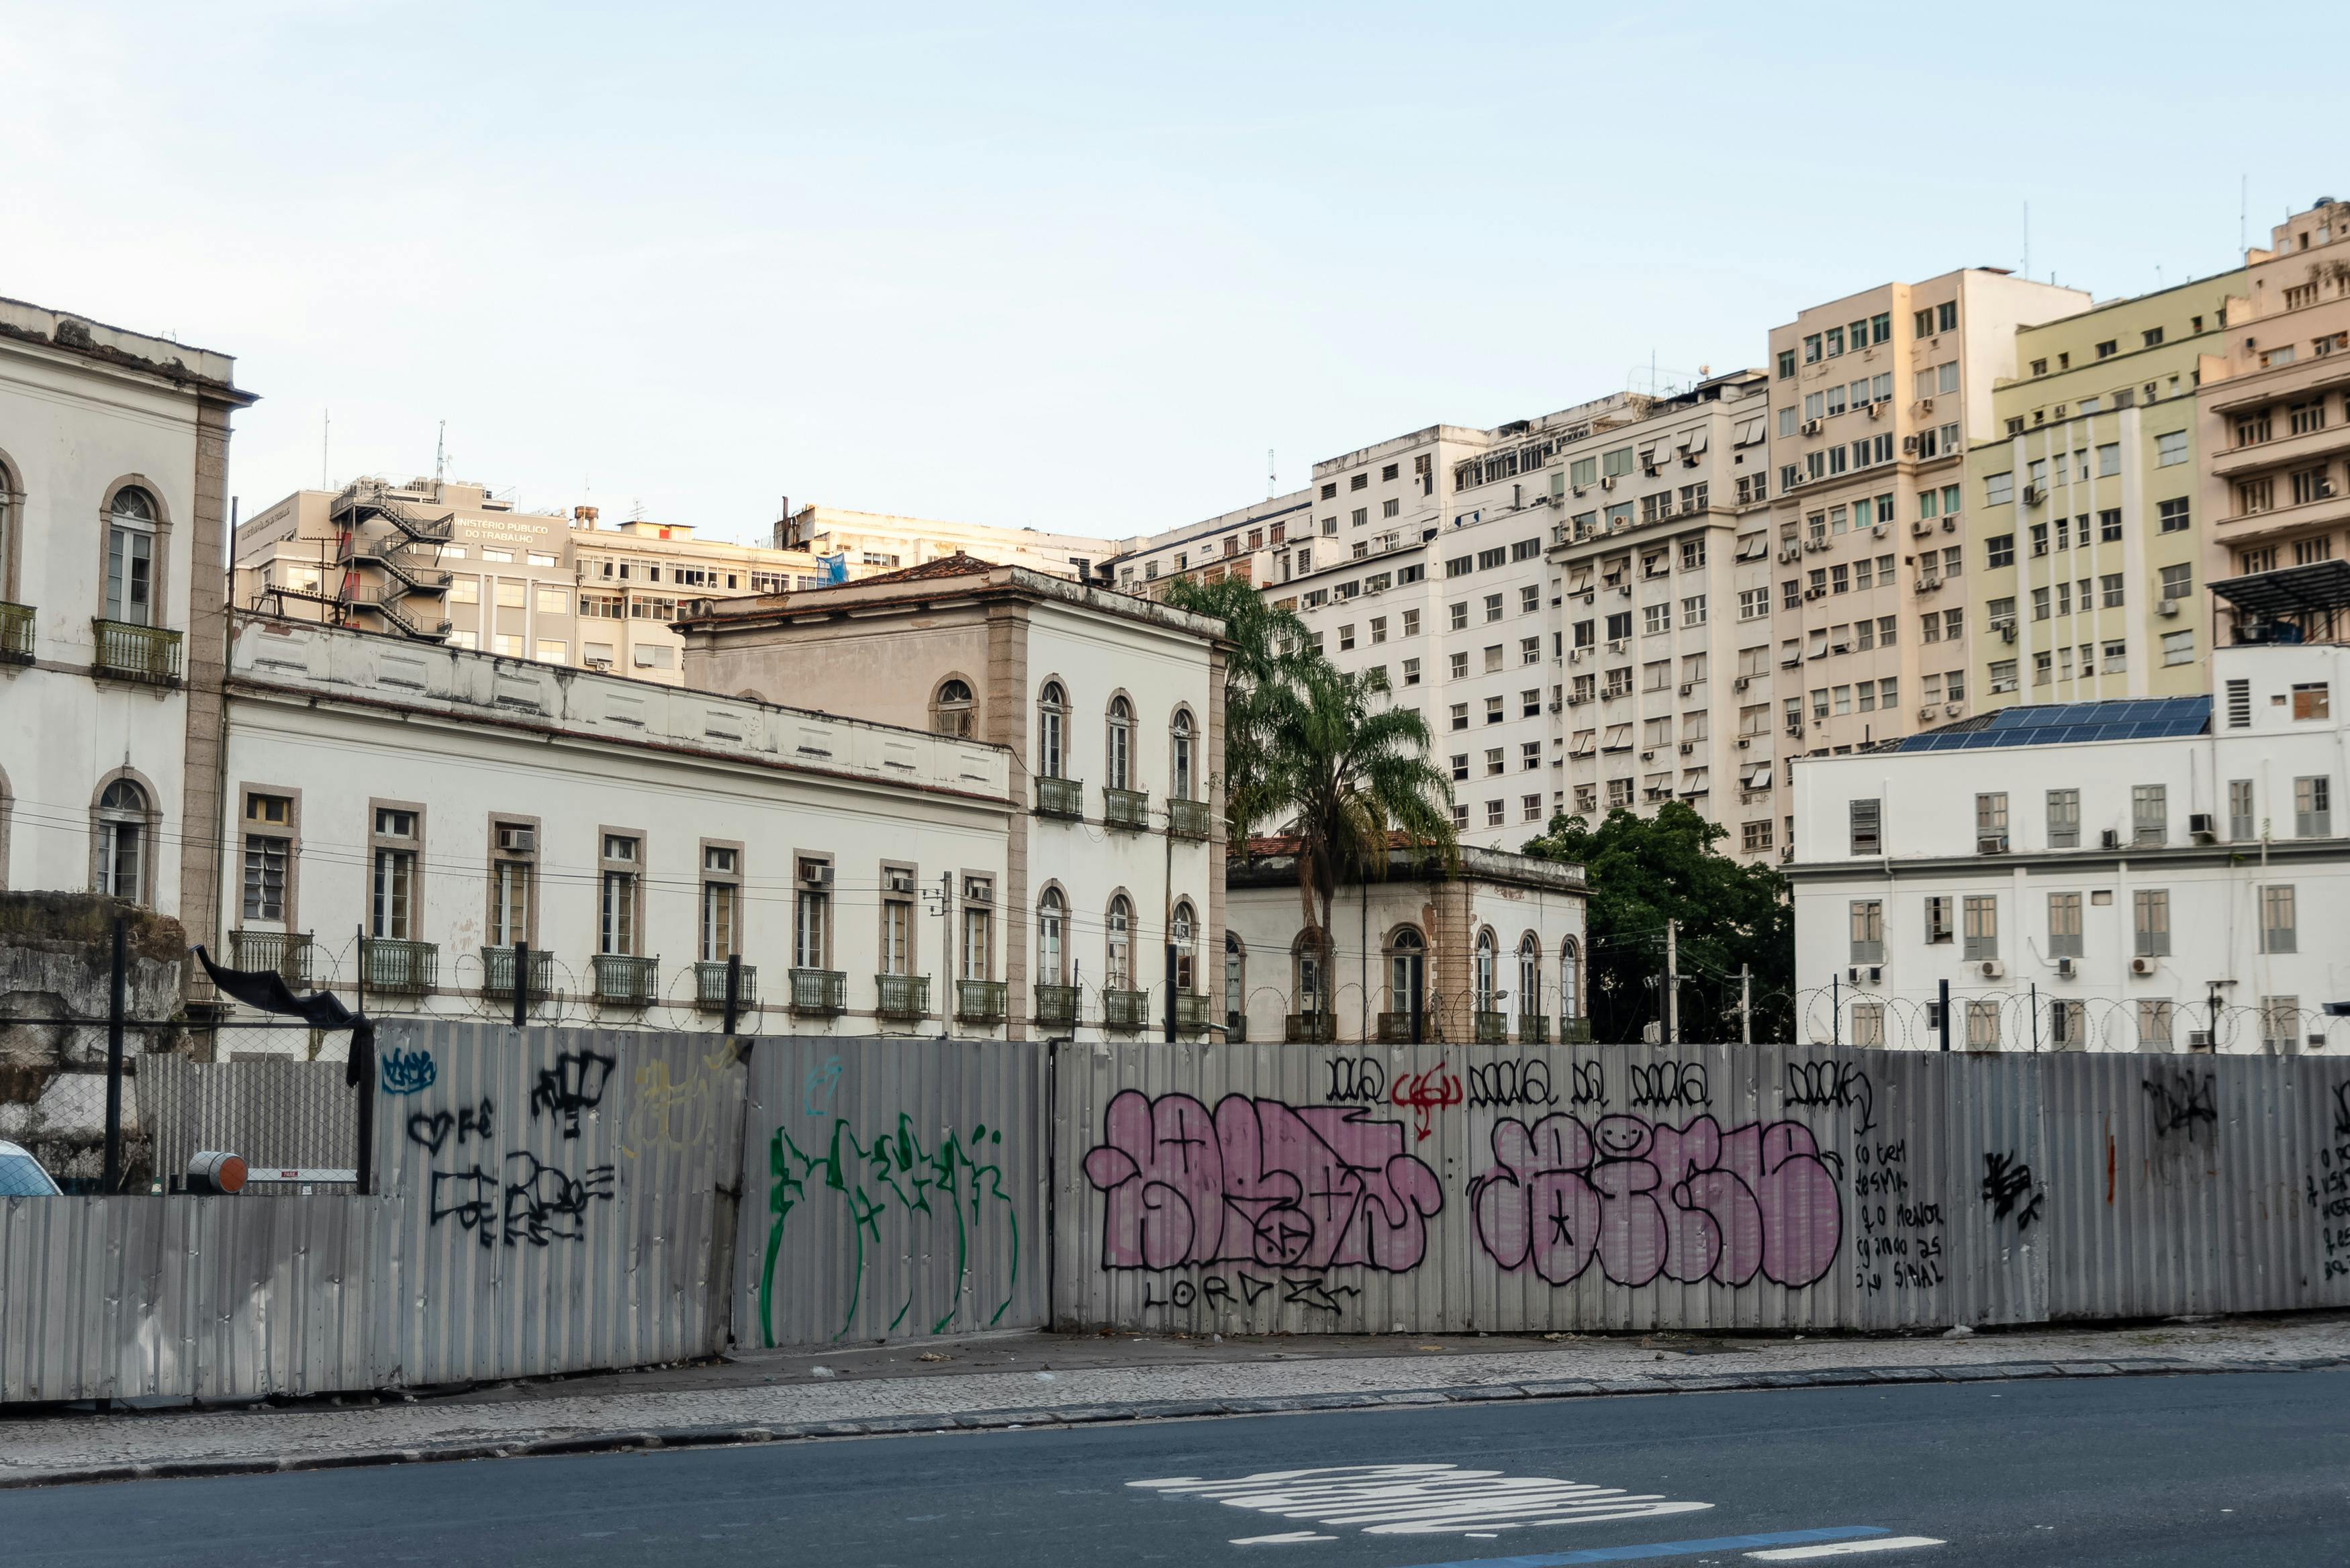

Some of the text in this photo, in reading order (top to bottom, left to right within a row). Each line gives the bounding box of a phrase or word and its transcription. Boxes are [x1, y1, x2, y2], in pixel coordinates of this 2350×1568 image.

[508, 521, 549, 534] PÚBLICO
[465, 529, 533, 544] DO TRABALHO
